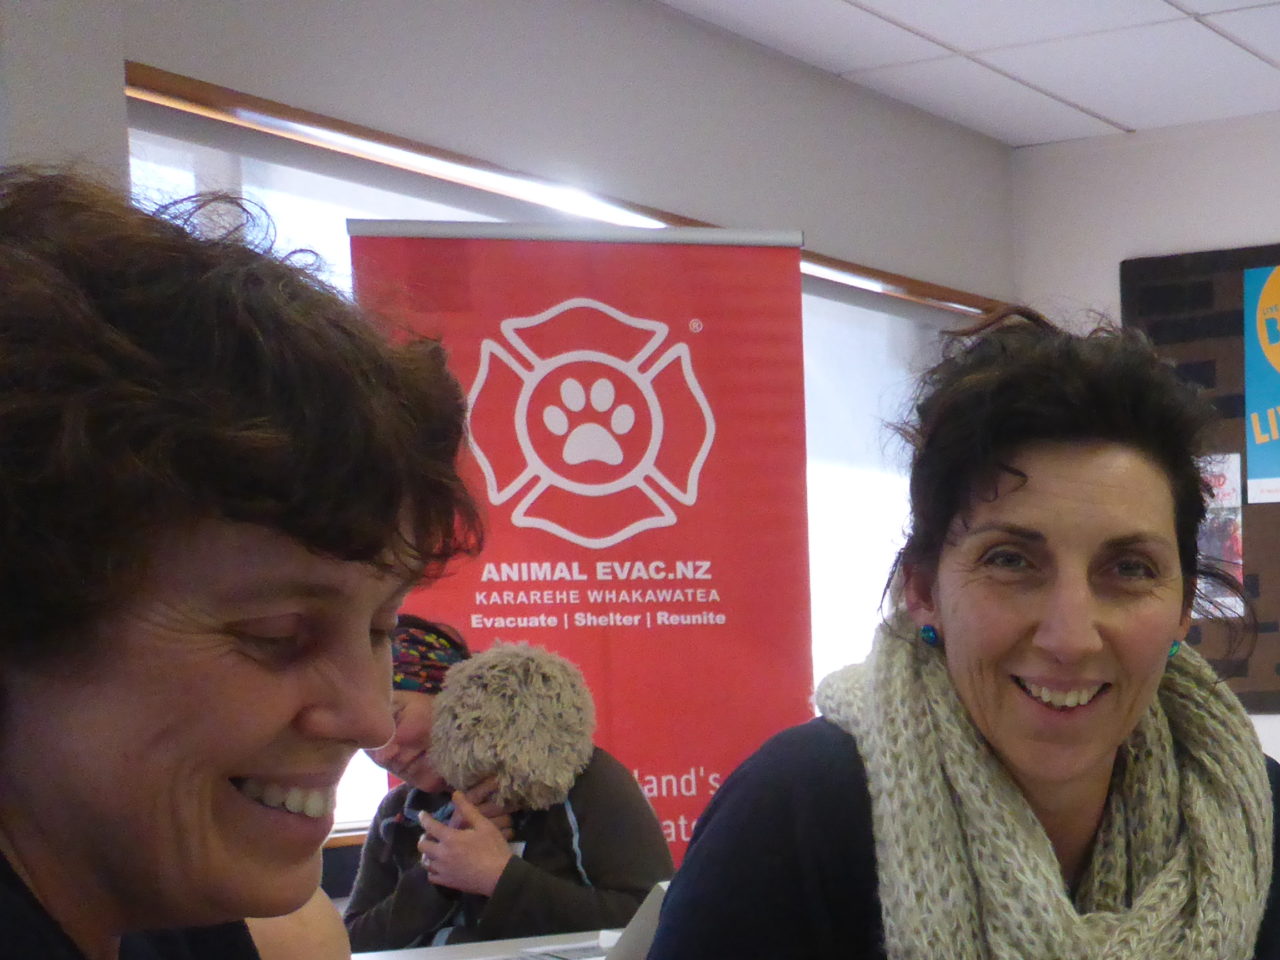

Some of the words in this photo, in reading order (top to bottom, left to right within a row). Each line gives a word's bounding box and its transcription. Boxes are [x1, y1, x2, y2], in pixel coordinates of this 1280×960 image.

[481, 562, 587, 582] ANIMAL
[596, 561, 712, 580] EVAC.NZ
[475, 590, 580, 605] KARAREHE
[587, 589, 721, 603] WHAKAWATEA
[470, 613, 558, 628] Evacuate
[574, 612, 641, 627] Shelter
[656, 611, 726, 625] Reunite
